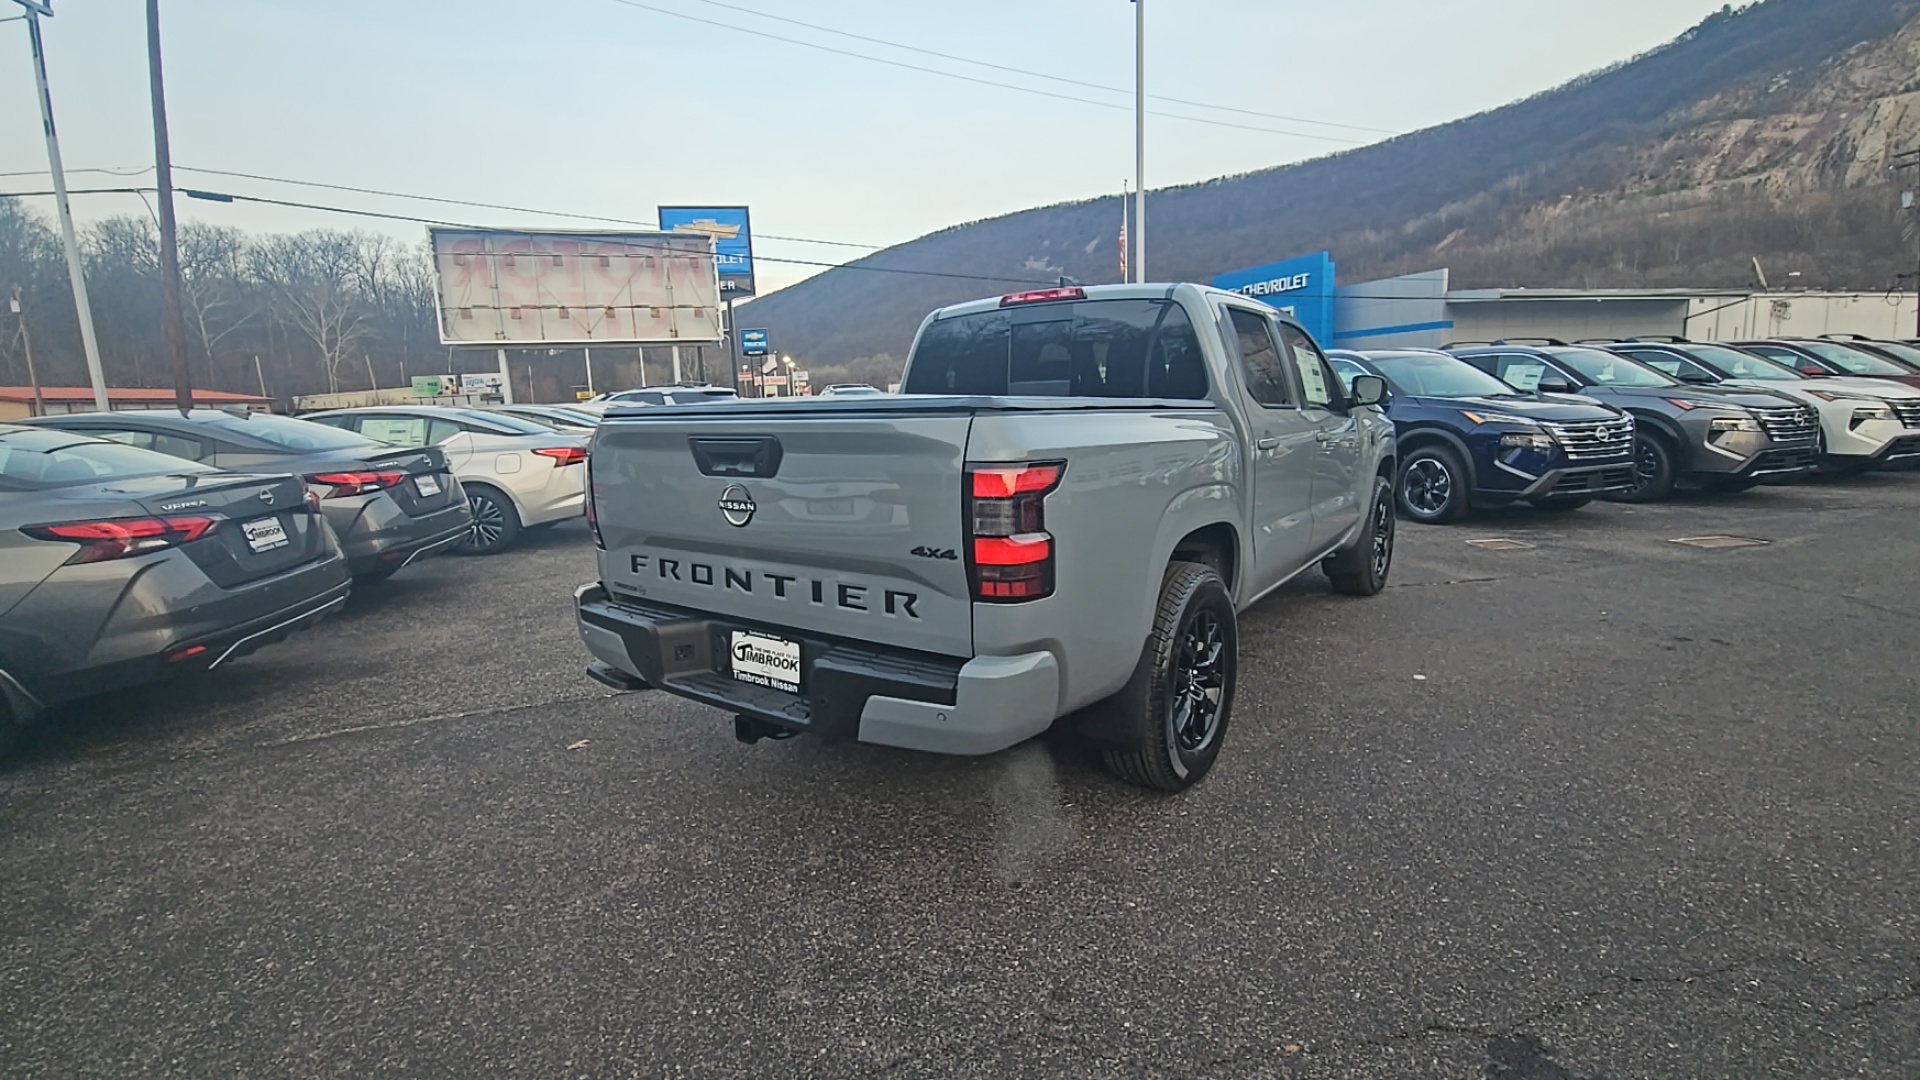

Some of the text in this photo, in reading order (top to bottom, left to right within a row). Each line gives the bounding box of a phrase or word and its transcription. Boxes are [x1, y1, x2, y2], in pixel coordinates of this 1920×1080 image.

[716, 253, 745, 264] OLET
[720, 280, 736, 290] ER
[1243, 272, 1310, 296] CHEVROLET
[161, 500, 208, 511] VERSA
[719, 501, 754, 511] NISSAN
[630, 554, 920, 618] FRONTIER
[734, 643, 799, 672] TIMBROOK
[733, 670, 798, 693] Timbrook Nissan
